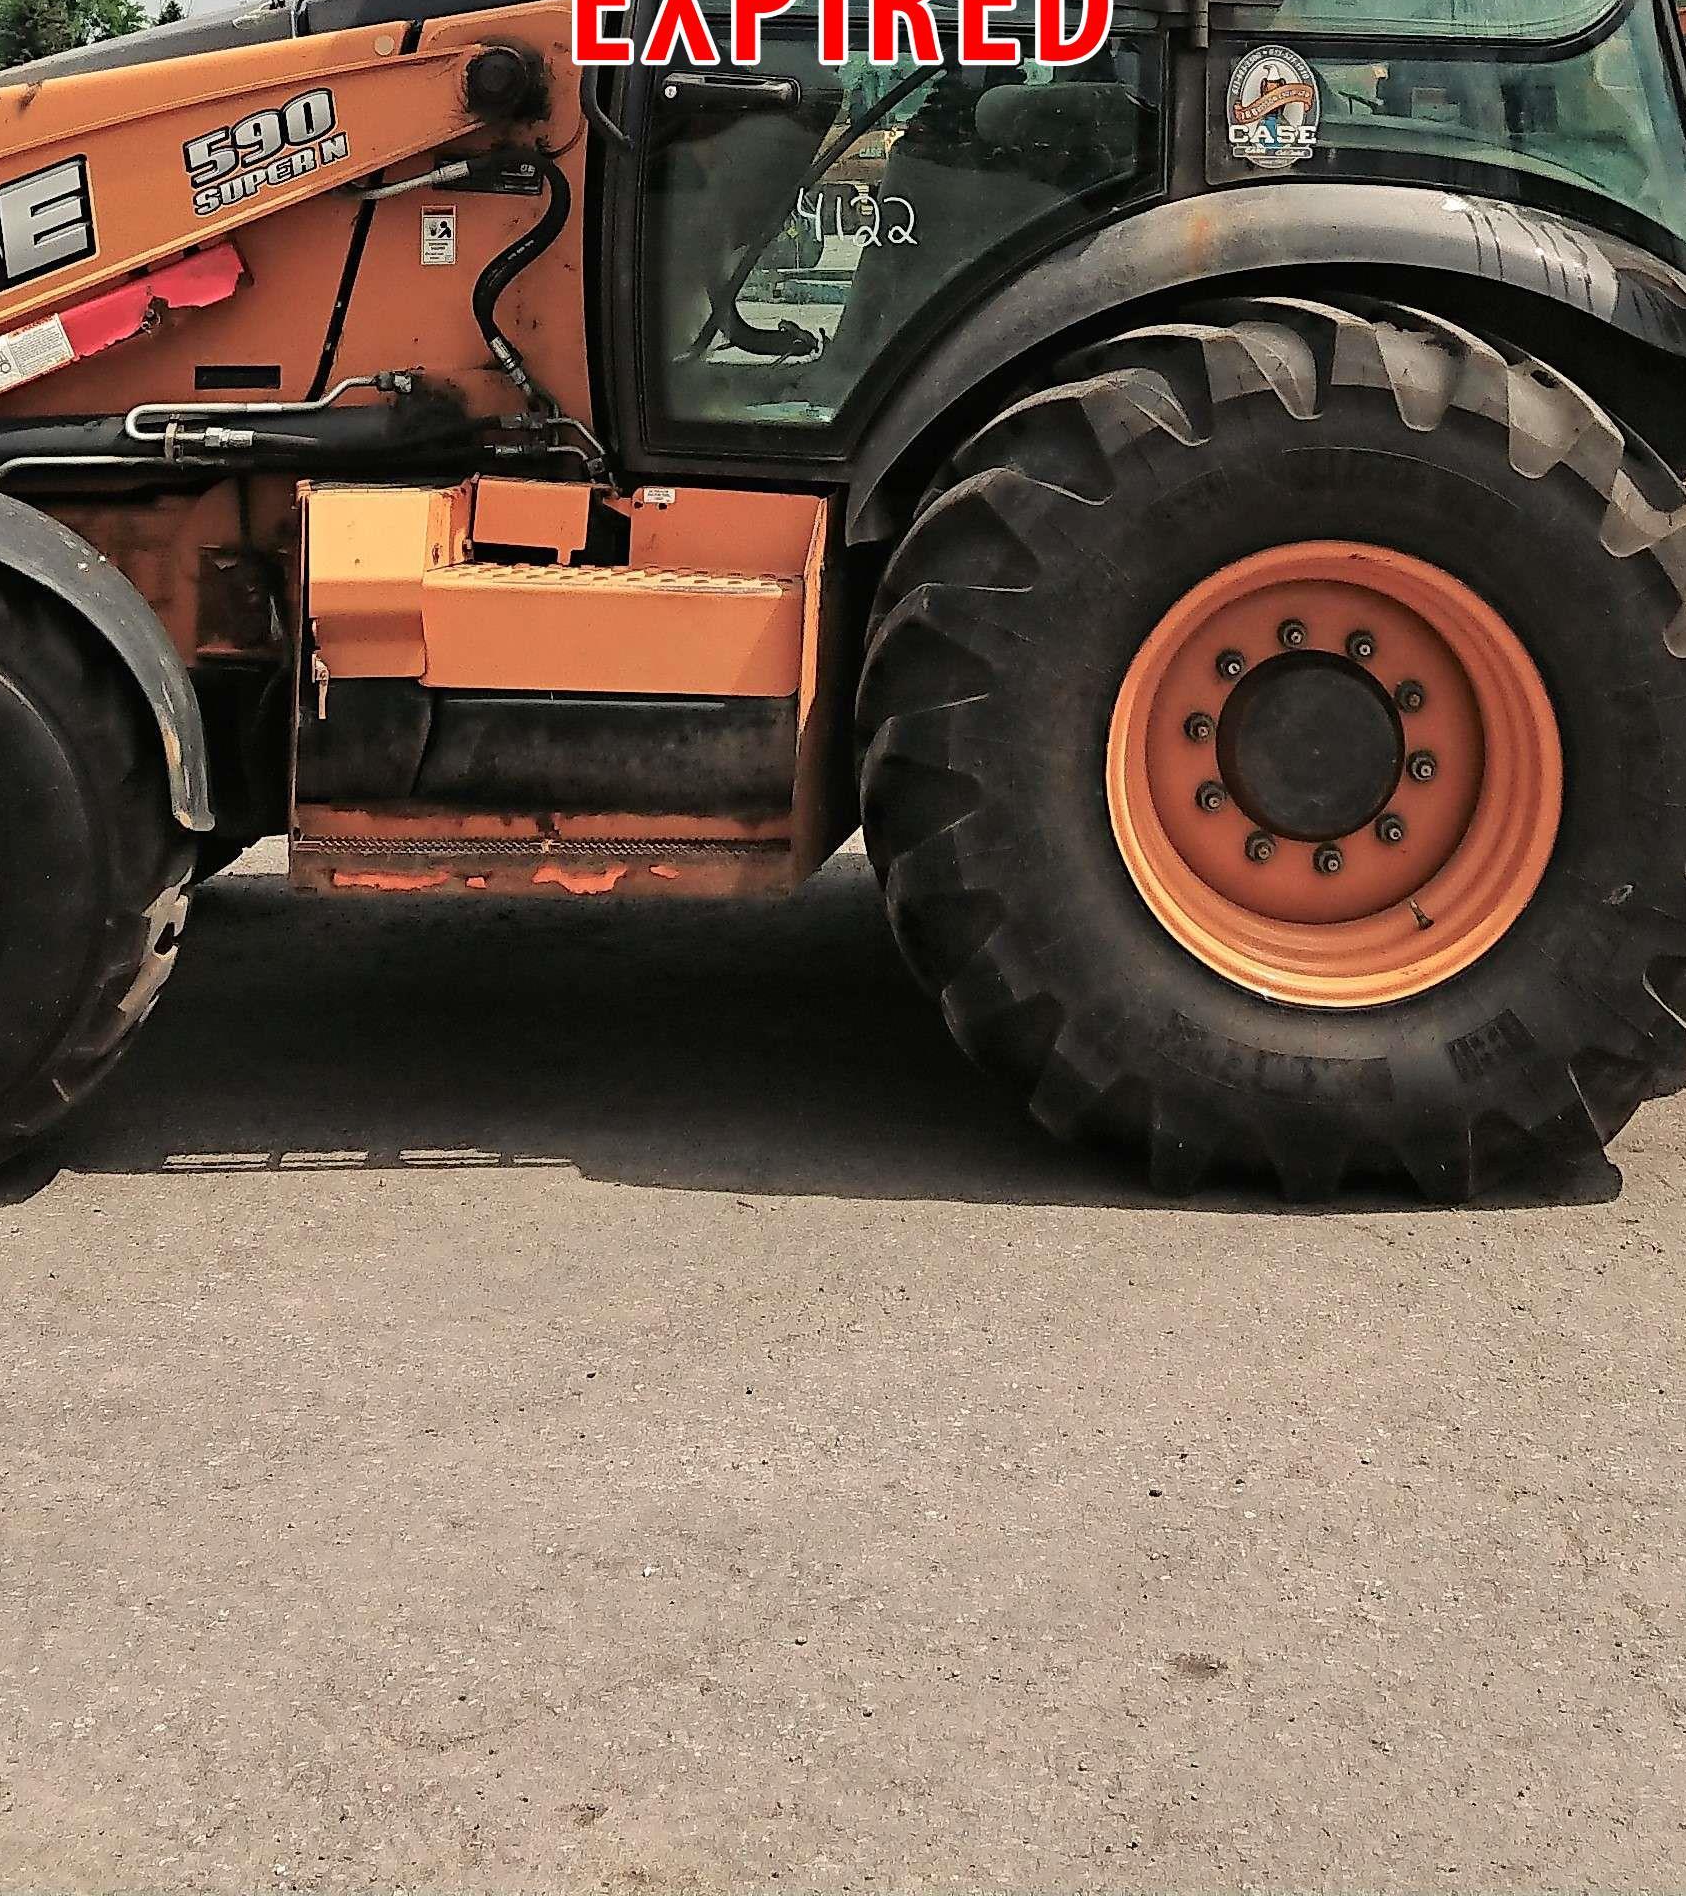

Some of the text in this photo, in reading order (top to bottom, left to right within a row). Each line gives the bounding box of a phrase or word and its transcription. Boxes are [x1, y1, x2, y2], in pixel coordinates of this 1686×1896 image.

[184, 89, 336, 188] 590
[1229, 125, 1317, 144] CASE
[194, 132, 348, 215] SUPER N
[796, 187, 918, 247] 4122
